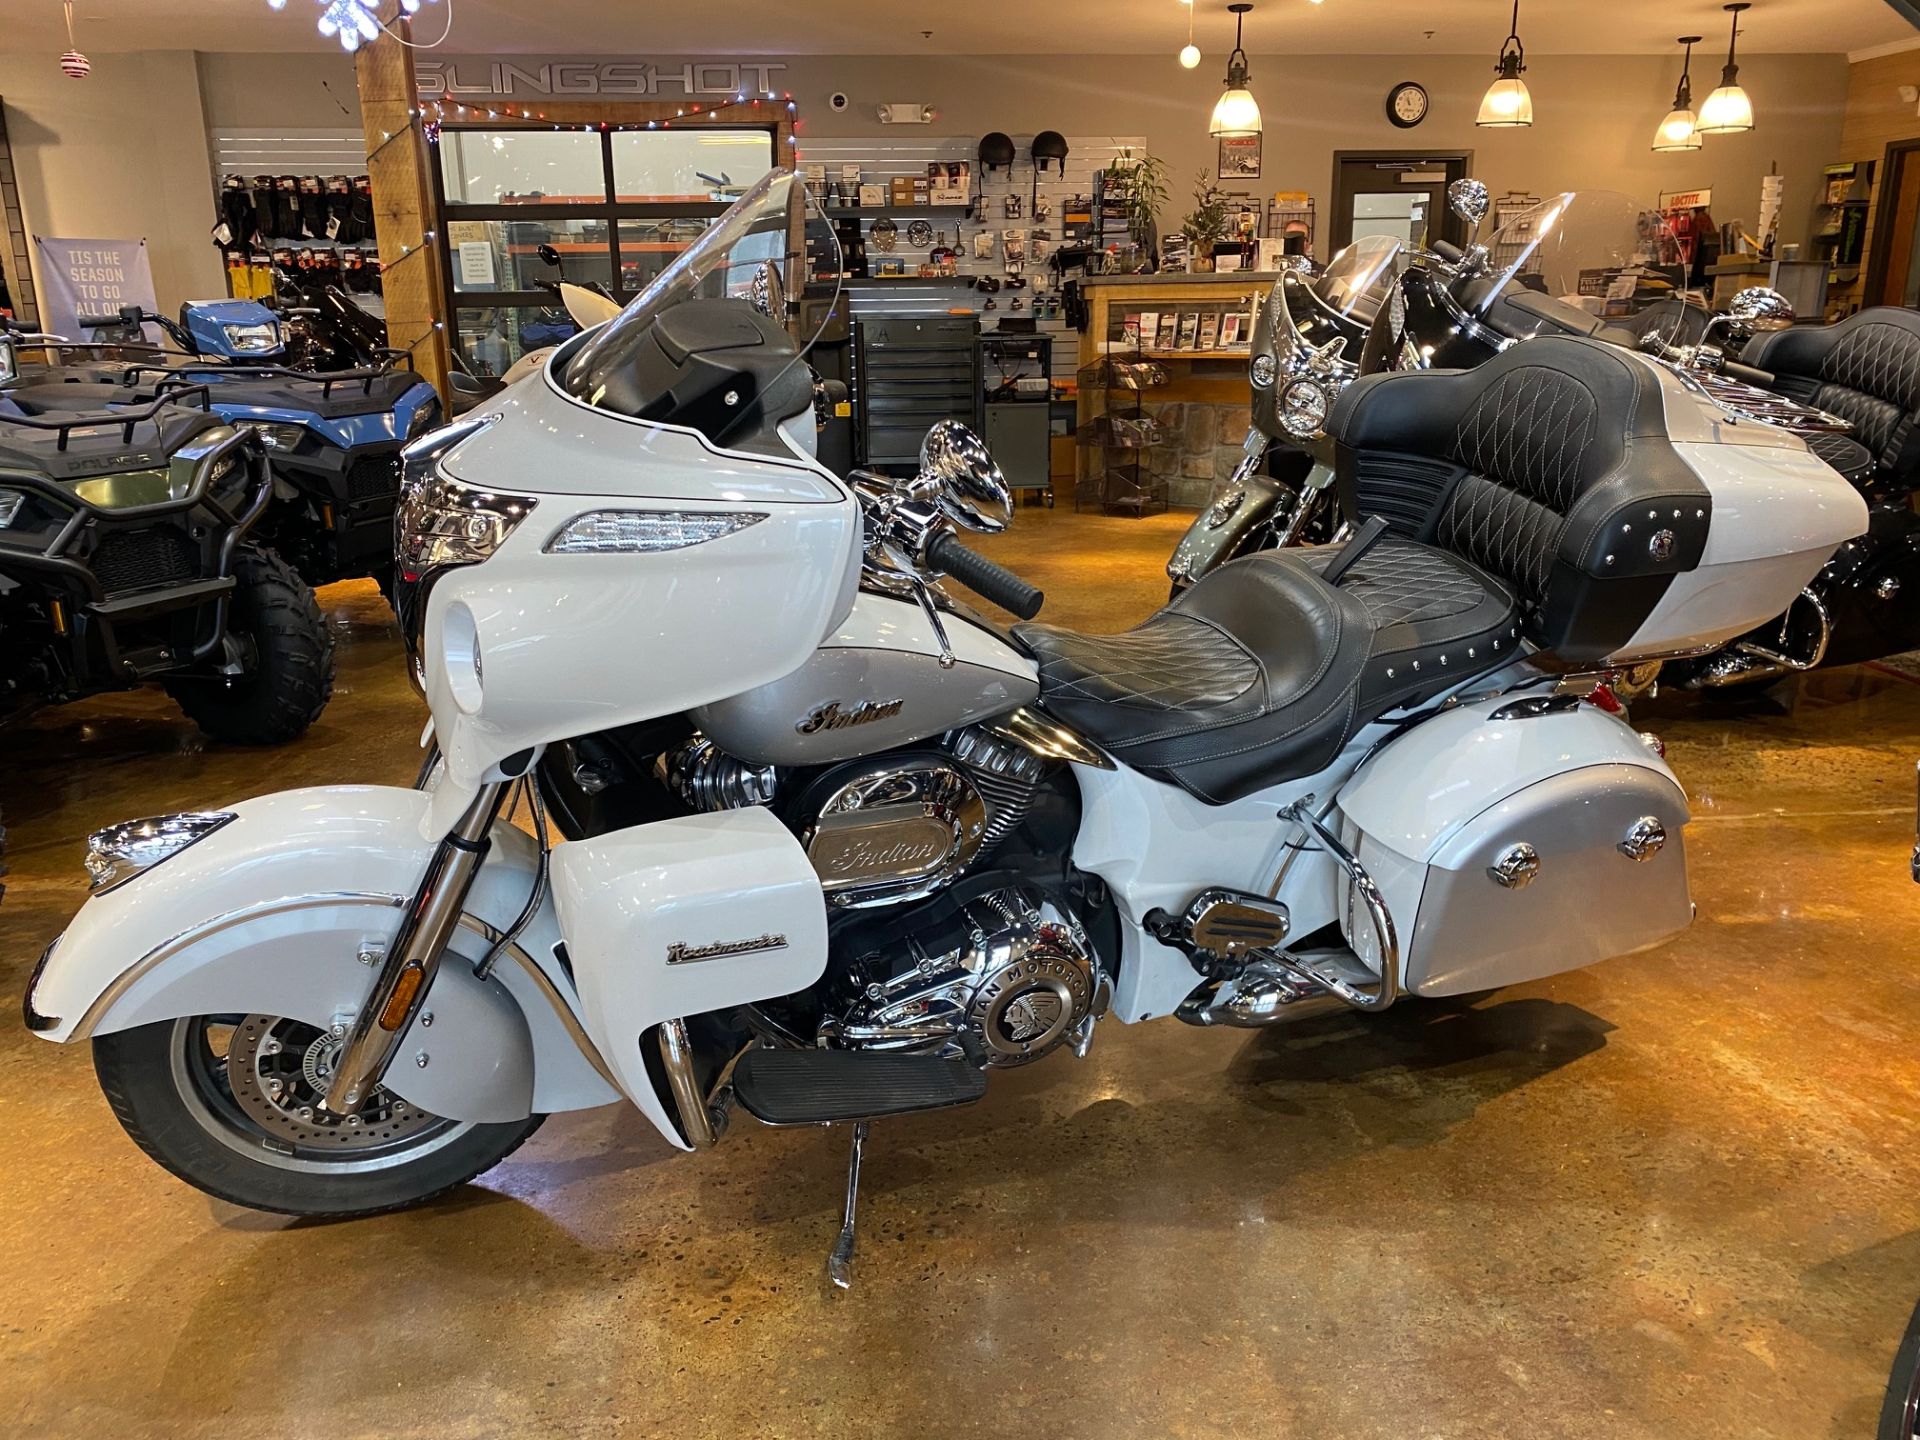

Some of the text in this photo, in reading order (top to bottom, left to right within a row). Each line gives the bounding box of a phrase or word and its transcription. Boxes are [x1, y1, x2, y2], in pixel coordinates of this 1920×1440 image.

[416, 62, 787, 94] SLINGSHOT
[1670, 193, 1700, 206] LOCTITE
[94, 251, 121, 265] THE
[70, 267, 125, 282] SEASON
[79, 284, 121, 299] TO GO
[76, 302, 100, 316] ALL
[66, 453, 152, 472] POLARIS
[795, 699, 904, 735] Indian
[830, 841, 935, 873] Indian
[666, 933, 789, 965] Roadmaster
[973, 960, 1086, 1049] NDIAN MOTORCYCL
